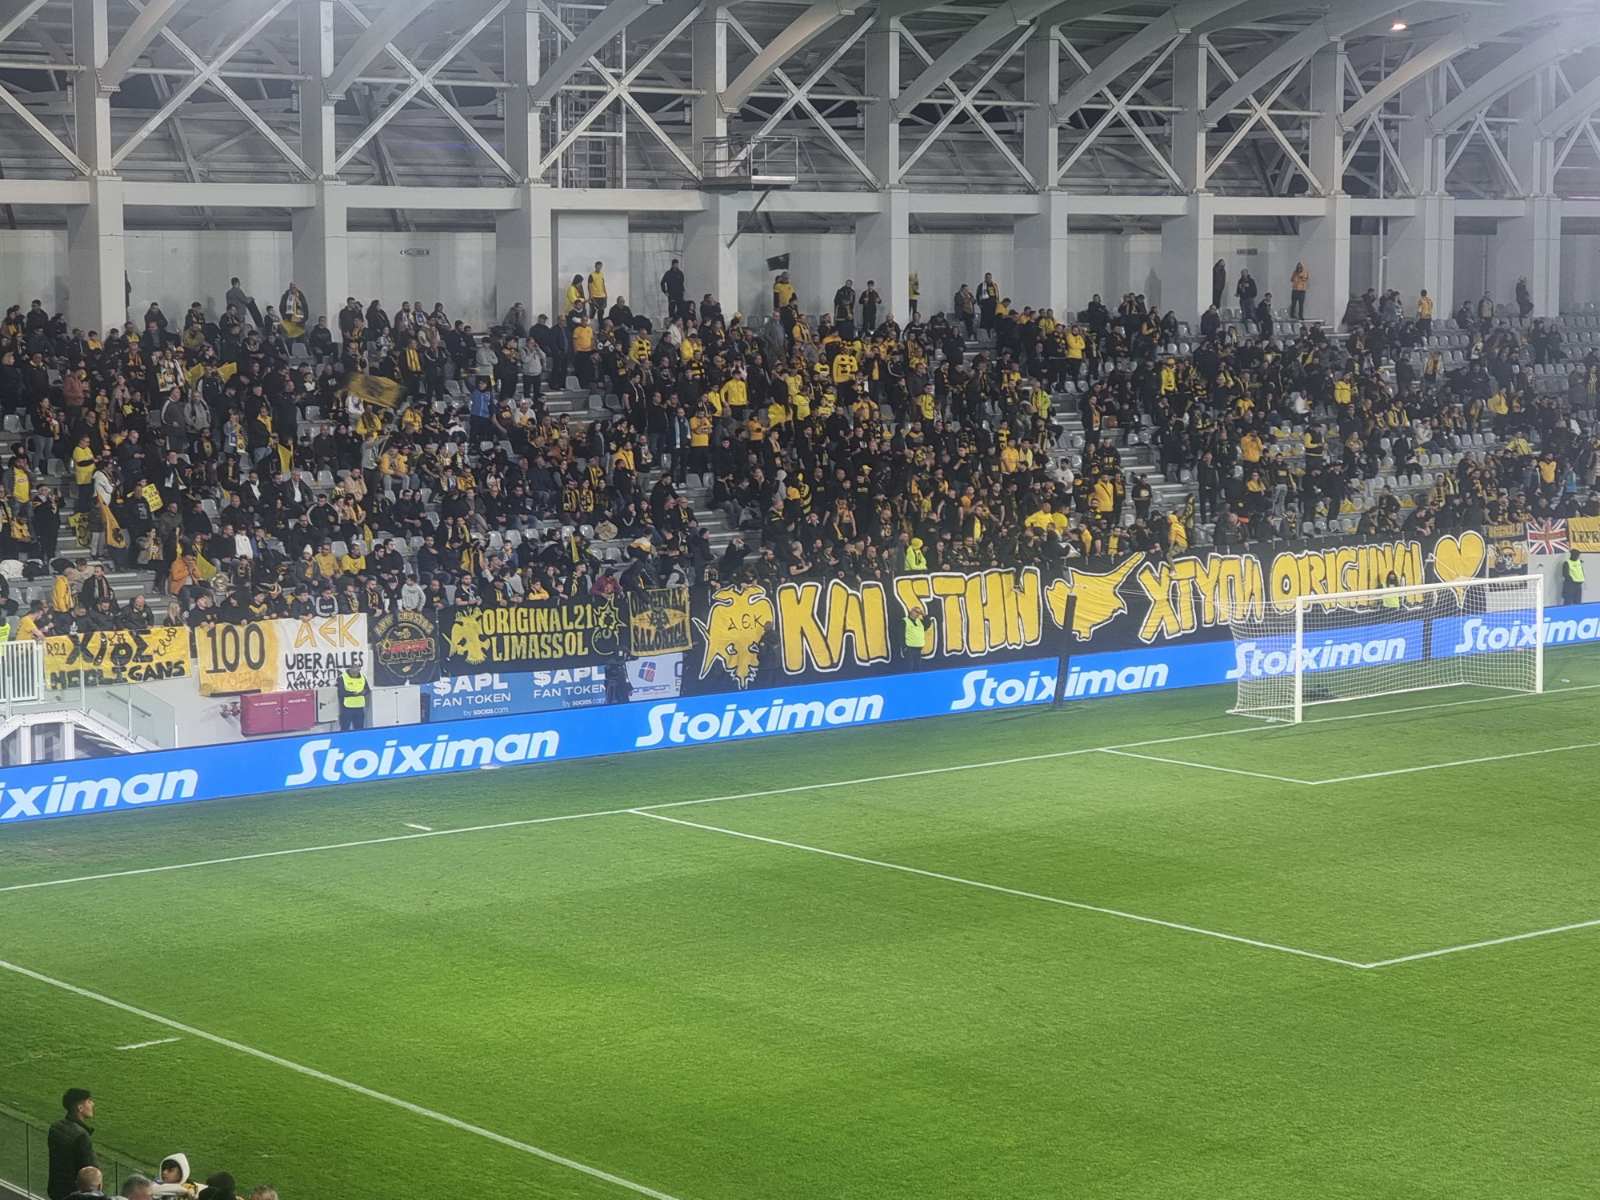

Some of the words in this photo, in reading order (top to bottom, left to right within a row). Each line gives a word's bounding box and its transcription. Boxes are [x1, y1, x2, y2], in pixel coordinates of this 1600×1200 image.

[206, 623, 266, 673] 100
[490, 631, 589, 662] LIMASSOL
[1455, 617, 1600, 653] Stoixima
[326, 651, 363, 669] ALLES
[1225, 637, 1406, 680] Stoiximan
[433, 698, 462, 708] FAN
[467, 692, 511, 705] TOKEN
[533, 687, 561, 698] FAN
[951, 663, 1168, 710] Stoiximan
[635, 694, 884, 747] Stoiximan
[285, 730, 560, 786] Stoiximan
